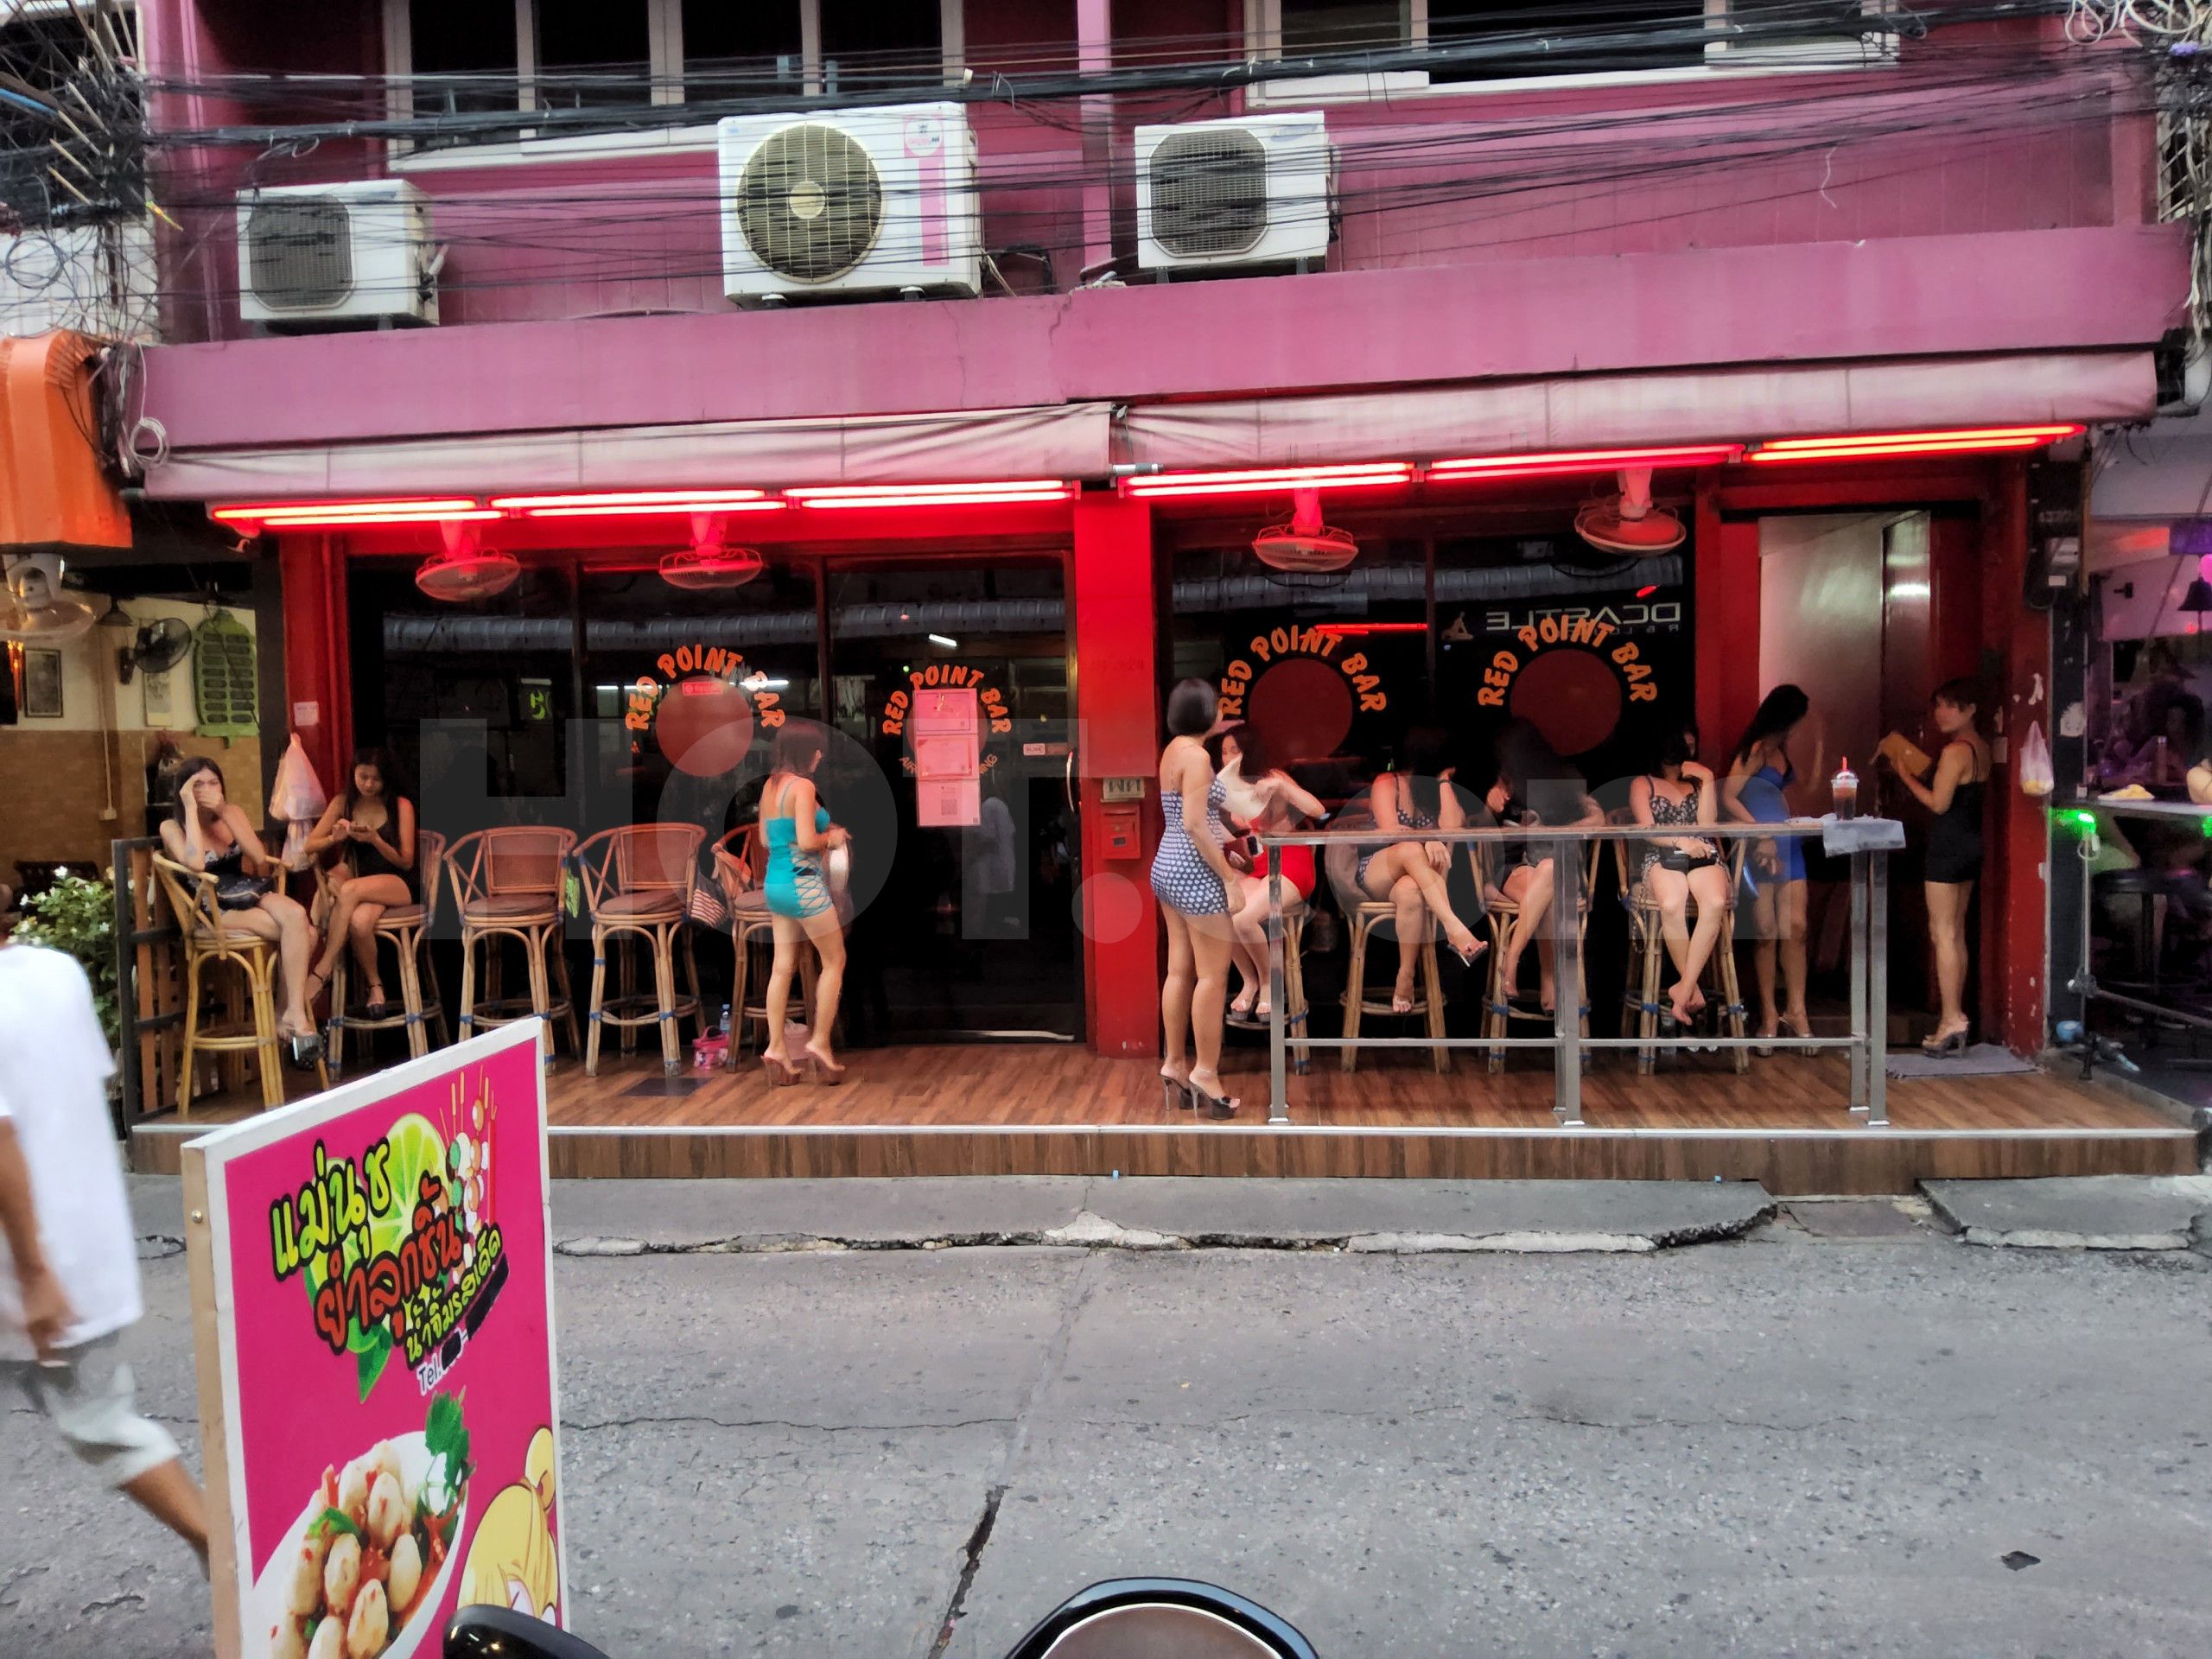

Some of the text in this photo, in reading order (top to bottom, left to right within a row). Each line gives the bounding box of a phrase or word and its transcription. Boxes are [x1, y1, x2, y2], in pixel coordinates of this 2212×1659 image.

[625, 643, 786, 731] RED POINT BAR
[882, 690, 908, 735] RED
[909, 664, 985, 690] POINT
[981, 687, 1013, 734] BAR
[1217, 625, 1387, 715] RED POINT BAR
[1478, 614, 1658, 706] RED POINT BAR
[418, 1356, 442, 1393] Tel.
